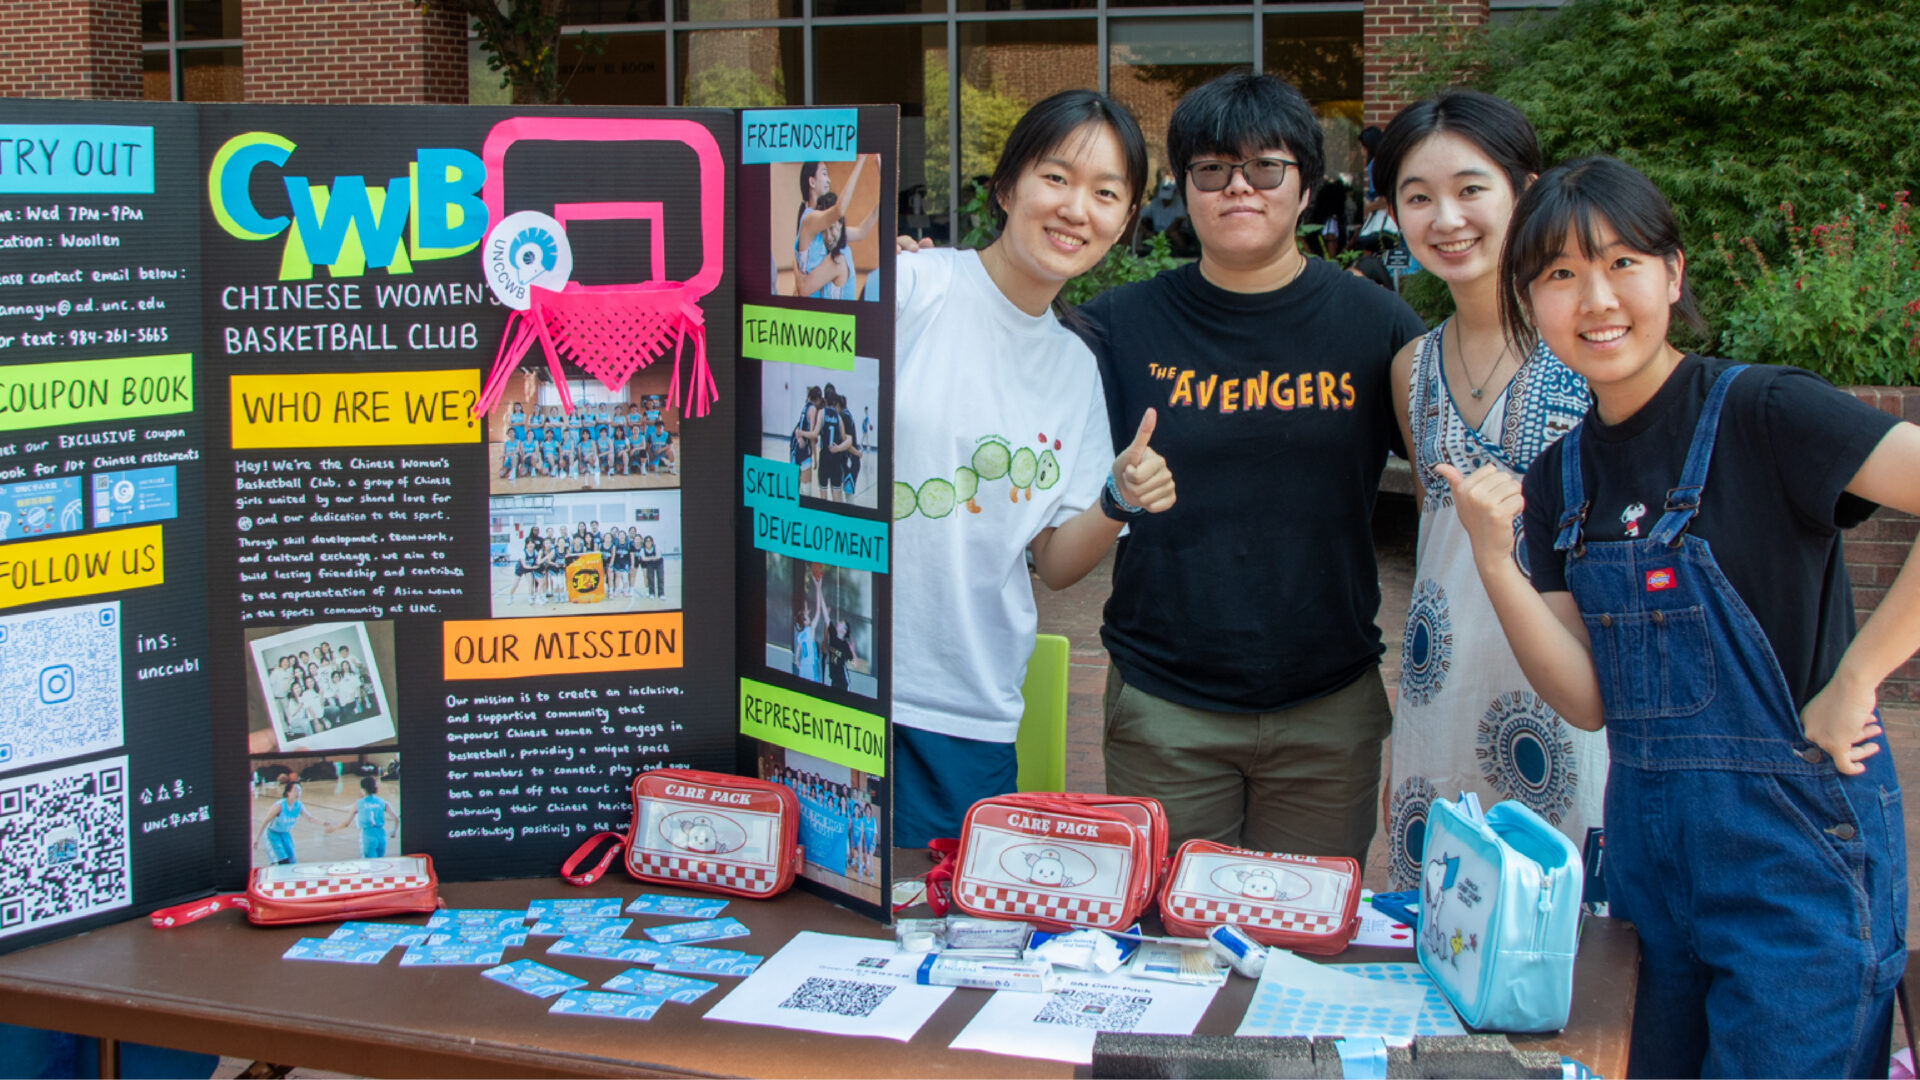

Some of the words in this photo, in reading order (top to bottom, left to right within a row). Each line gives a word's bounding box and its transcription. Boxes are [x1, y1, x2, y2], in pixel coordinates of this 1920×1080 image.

[747, 122, 857, 152] FRIENDSHIP
[74, 140, 142, 176] OUT
[25, 204, 60, 221] Wed
[68, 205, 144, 222] 7PM-9PM
[208, 131, 489, 280] CWB
[60, 233, 120, 248] Woollen
[29, 268, 83, 284] contact
[91, 268, 129, 283] email
[138, 266, 187, 280] below:
[493, 239, 526, 300] UNCCWB
[221, 284, 362, 310] CHINESE
[20, 331, 65, 346] text:
[68, 327, 169, 346] 984-261-5665
[225, 323, 397, 354] BASKETBALL
[409, 322, 479, 350] CLUB
[745, 319, 853, 353] TEAMWORK
[122, 375, 188, 406] BOOK
[1148, 363, 1177, 380] THE
[1168, 370, 1357, 414] AVENGERS
[242, 391, 321, 424] WHO
[333, 391, 390, 424] ARE
[405, 389, 477, 428] WE?
[24, 441, 50, 453] our
[58, 428, 137, 449] EXCLUSIVE
[144, 428, 186, 441] coupon
[33, 462, 58, 477] for
[64, 460, 86, 473] 10+
[93, 454, 137, 469] Chinese
[235, 459, 268, 474] Hey!
[272, 458, 311, 472] We're
[319, 458, 343, 471] the
[350, 457, 395, 470] Chinese
[401, 457, 450, 470] Women's
[236, 477, 302, 490] Basketball
[348, 479, 357, 488] a
[363, 478, 394, 490] group
[397, 476, 409, 489] of
[414, 476, 452, 487] Chinese
[746, 467, 796, 501] SKILL
[235, 495, 263, 510] girls
[268, 494, 306, 505] united
[315, 493, 330, 508] by
[335, 496, 354, 504] our
[360, 493, 395, 504] shared
[403, 493, 425, 504] love
[432, 493, 452, 504] for
[256, 513, 278, 525] and
[284, 514, 304, 523] our
[310, 511, 367, 523] dedication
[371, 511, 384, 521] to
[388, 510, 408, 521] the
[238, 536, 279, 550] Through
[283, 535, 306, 546] skill
[758, 512, 884, 563] DEVELOPMENT
[122, 544, 156, 575] US
[238, 552, 260, 563] and
[267, 551, 314, 563] cultural
[381, 552, 399, 561] we
[403, 550, 425, 560] aim
[430, 550, 446, 561] to
[240, 569, 268, 582] build
[273, 569, 312, 583] lasting
[317, 567, 377, 582] friendship
[383, 566, 405, 577] and
[240, 592, 254, 602] to
[258, 590, 277, 601] the
[281, 586, 366, 602] representation
[372, 585, 385, 598] of
[393, 585, 424, 597] Asian
[428, 586, 463, 596] women
[240, 610, 254, 621] in
[256, 607, 276, 619] the
[280, 606, 315, 620] sports
[322, 604, 384, 618] community
[389, 603, 404, 614] at
[137, 633, 178, 653] ins:
[454, 633, 519, 664] OUR
[534, 628, 676, 661] MISSION
[446, 695, 468, 708] Our
[473, 694, 514, 706] mission
[520, 692, 531, 704] is
[535, 691, 550, 702] to
[558, 688, 599, 700] create
[606, 688, 620, 697] an
[447, 712, 470, 724] and
[476, 710, 537, 724] supportive
[545, 707, 610, 723] community
[617, 704, 646, 716] that
[446, 730, 499, 744] empowers
[506, 727, 549, 739] Chinese
[555, 726, 593, 737] women
[601, 724, 615, 735] to
[624, 723, 664, 738] engage
[670, 720, 683, 732] in
[744, 693, 883, 759] REPRESENTATION
[519, 745, 575, 761] providing
[579, 746, 587, 755] a
[594, 744, 631, 759] unique
[637, 743, 670, 755] space
[447, 769, 469, 781] for
[473, 766, 524, 779] members
[531, 766, 545, 777] to
[448, 788, 473, 800] both
[478, 788, 494, 798] on
[499, 784, 519, 796] and
[525, 785, 544, 797] off
[550, 785, 569, 795] the
[664, 783, 706, 799] CARE
[710, 791, 752, 805] PACK
[448, 806, 502, 821] embracing
[510, 803, 539, 814] their
[546, 802, 589, 813] Chinese
[448, 826, 515, 841] contributing
[575, 822, 588, 832] to
[593, 821, 609, 832] the
[1007, 813, 1051, 832] CARE
[1055, 821, 1099, 838] PACK
